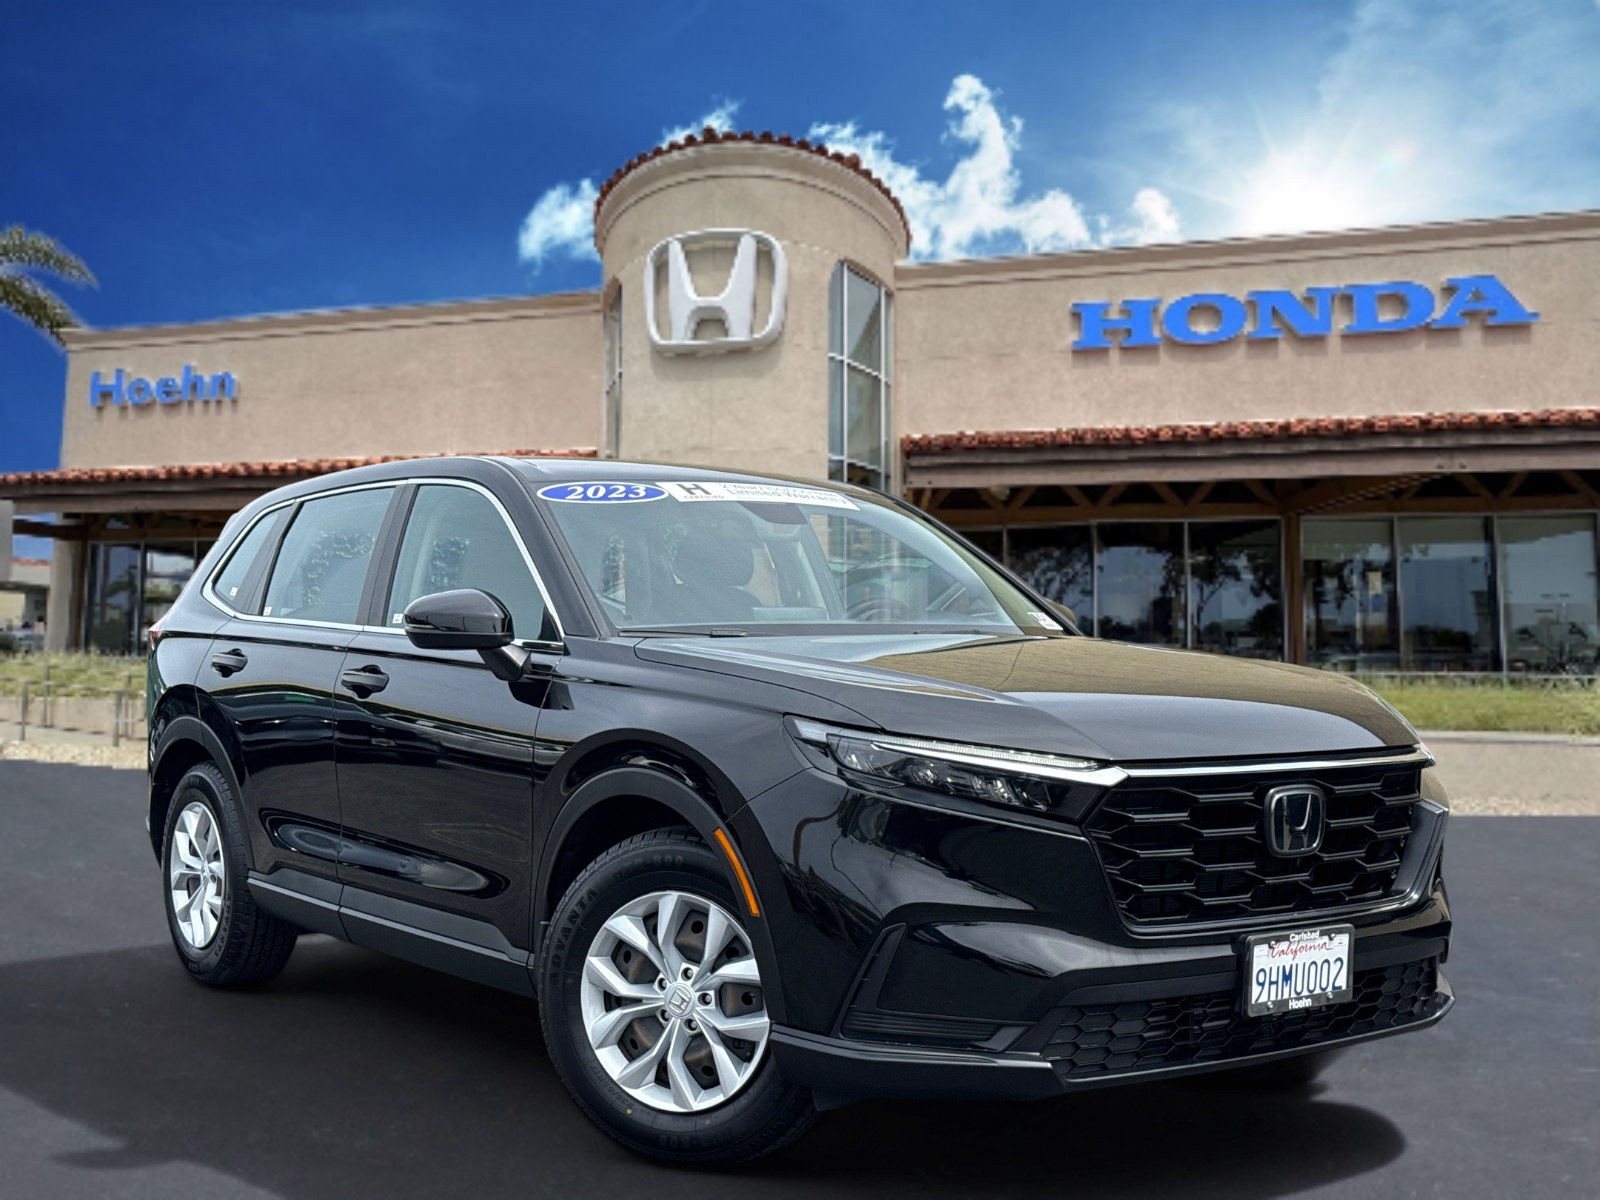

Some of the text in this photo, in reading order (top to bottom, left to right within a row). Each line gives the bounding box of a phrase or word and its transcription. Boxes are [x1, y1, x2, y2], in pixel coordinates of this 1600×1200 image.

[1071, 274, 1541, 351] HONDA
[89, 363, 236, 408] Hoehn
[565, 484, 647, 500] 2023
[549, 887, 600, 986] ADVANTA
[1269, 940, 1334, 961] California
[1289, 930, 1320, 942] Carlsbad
[1254, 957, 1344, 1004] 9HMU002
[1288, 997, 1313, 1010] Hoehn
